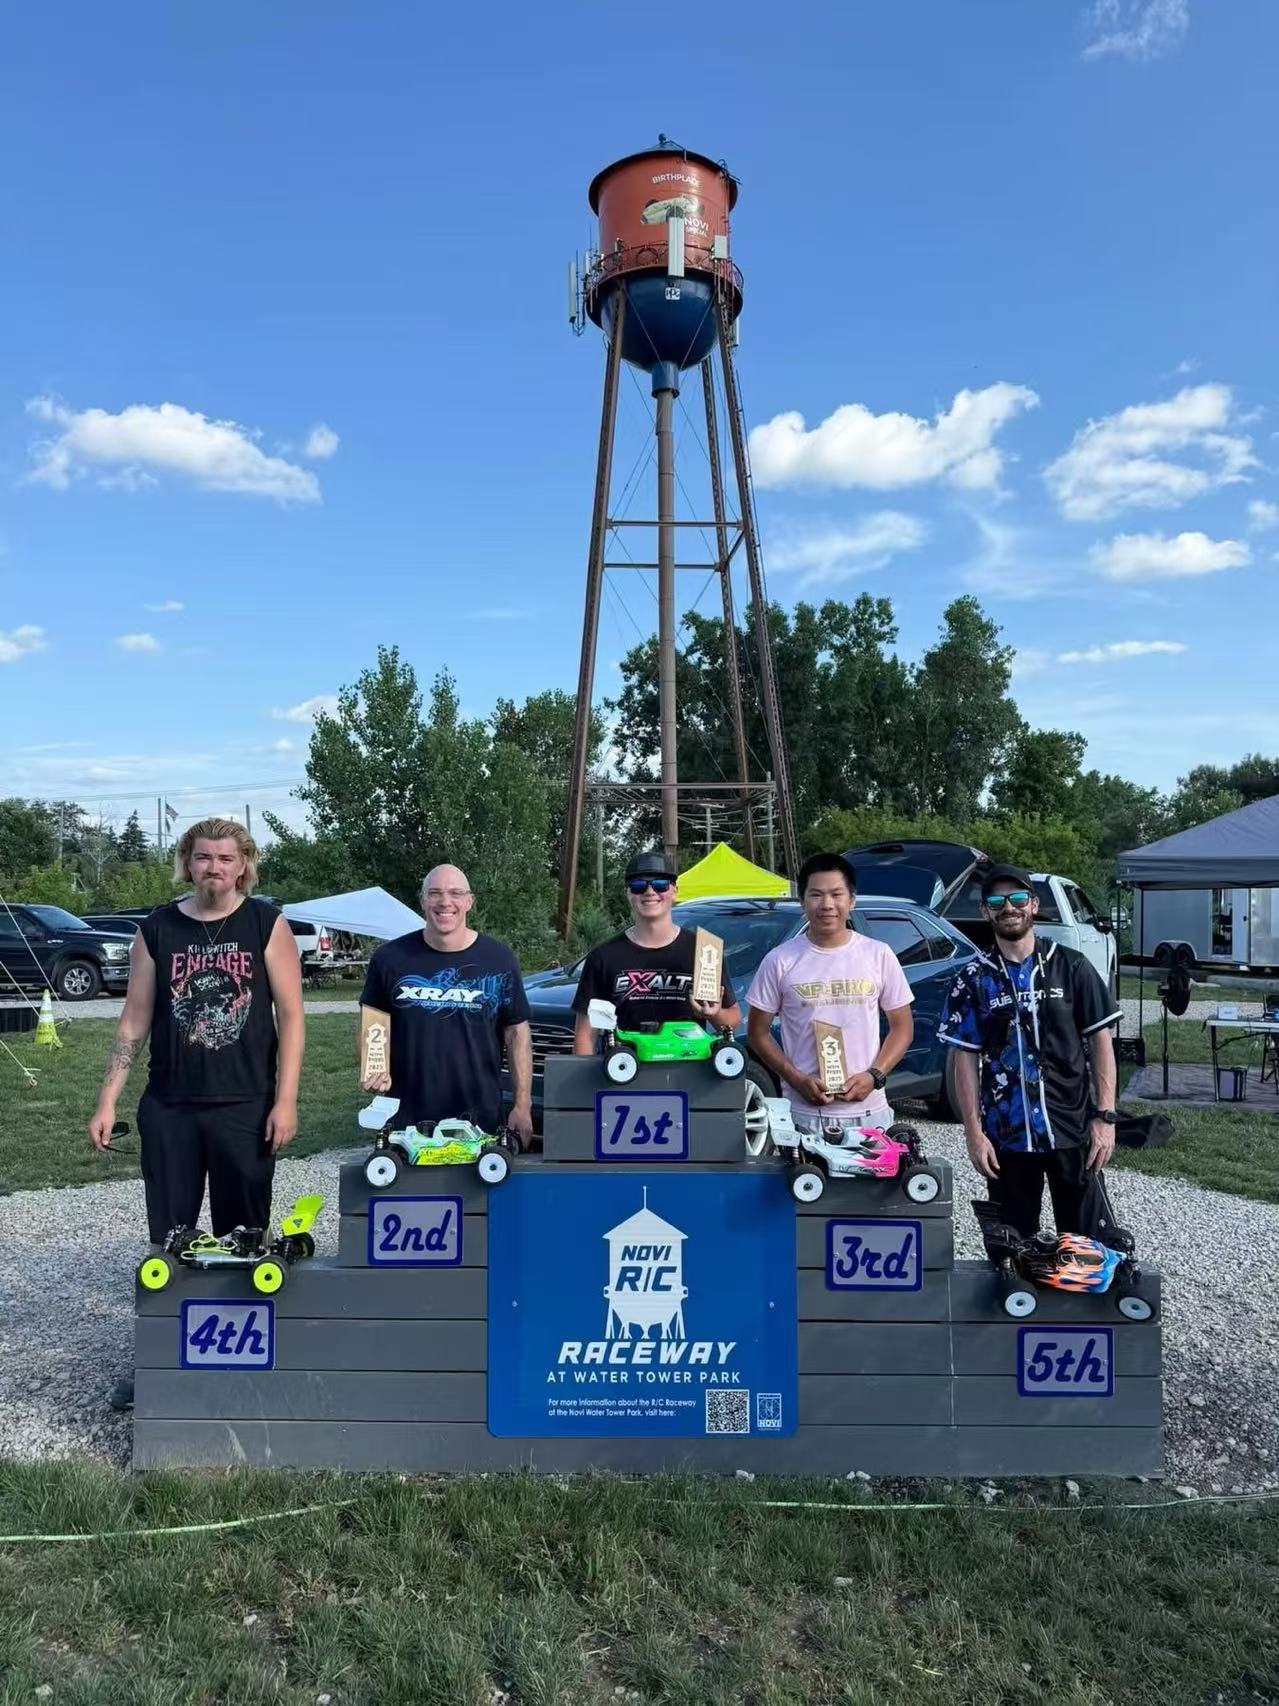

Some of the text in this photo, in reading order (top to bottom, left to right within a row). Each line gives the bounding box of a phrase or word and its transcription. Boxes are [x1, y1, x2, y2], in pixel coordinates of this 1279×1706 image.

[684, 217, 709, 231] NOVI
[172, 951, 253, 980] ENGAGE
[396, 985, 484, 1003] XRAY
[615, 971, 693, 998] EXALT
[371, 1028, 382, 1043] 2
[825, 1041, 836, 1056] 3
[610, 1105, 673, 1145] 1st
[379, 1209, 452, 1251] 2nd
[621, 1245, 672, 1261] NOVI
[836, 1233, 913, 1279] 3rd
[615, 1266, 677, 1292] R/C
[189, 1310, 265, 1354] 4th
[557, 1341, 737, 1365] RACEWAY
[1027, 1338, 1104, 1383] 5th
[547, 1371, 741, 1384] AT WATER TOWER PARK
[548, 1398, 559, 1406] For
[579, 1398, 617, 1406] information
[618, 1398, 637, 1406] about
[639, 1398, 650, 1406] the
[652, 1398, 664, 1406] R/C
[665, 1398, 697, 1408] Raceway
[548, 1408, 556, 1416] at
[557, 1408, 568, 1416] the
[569, 1408, 585, 1416] Novi
[586, 1408, 605, 1416] Water
[606, 1408, 625, 1416] Tower
[645, 1408, 658, 1416] visit
